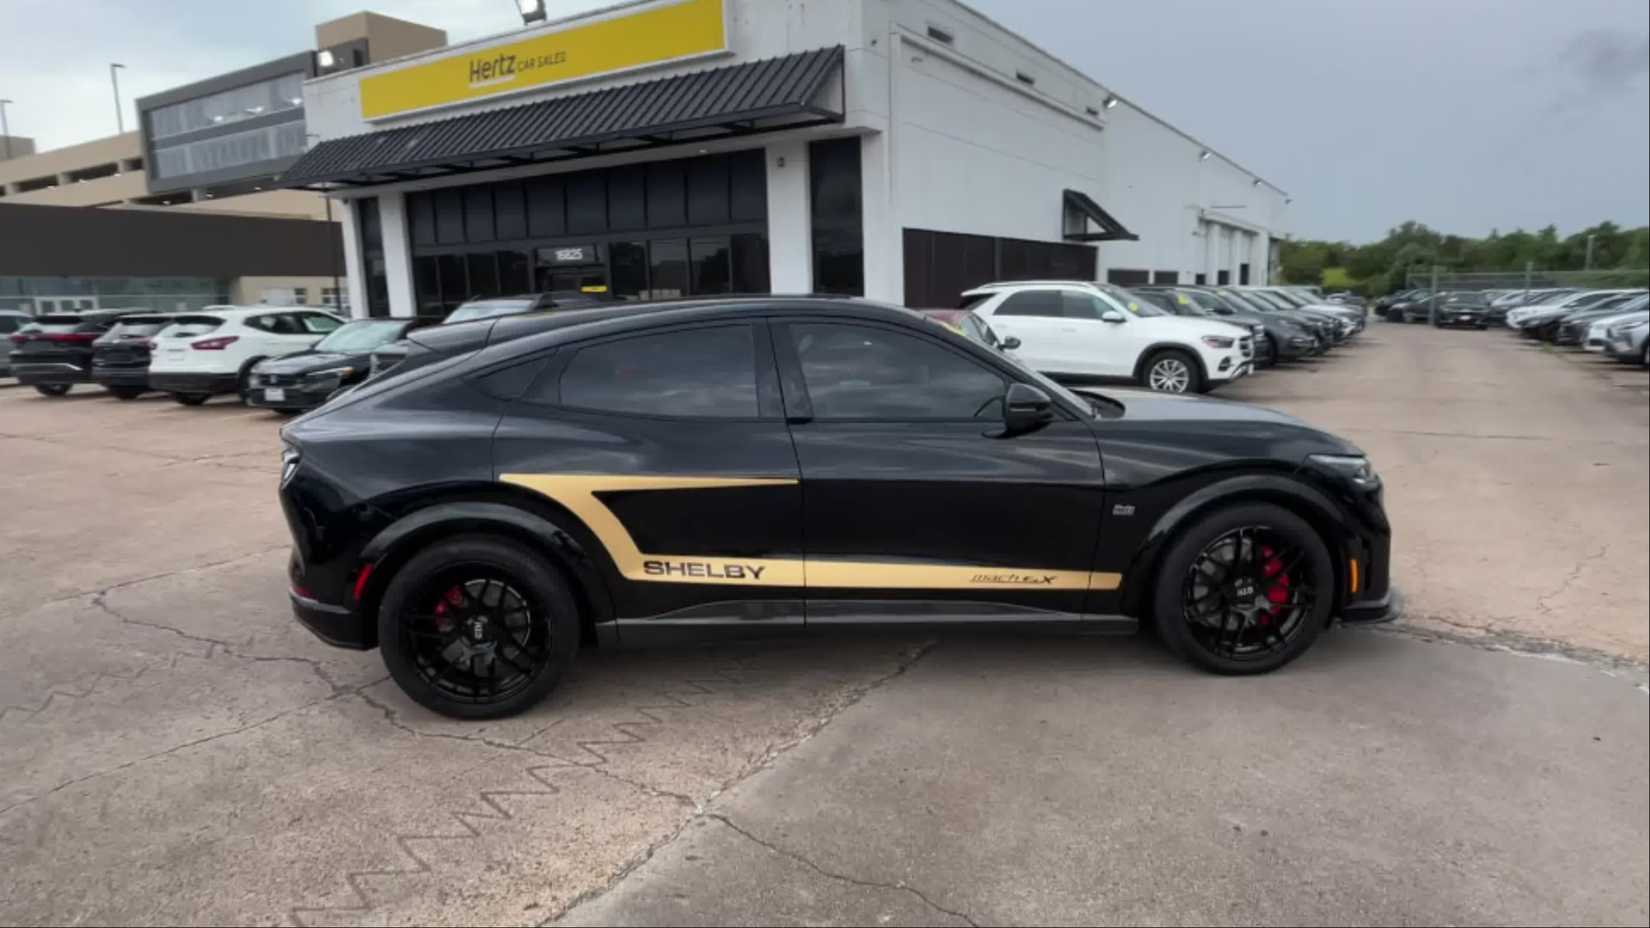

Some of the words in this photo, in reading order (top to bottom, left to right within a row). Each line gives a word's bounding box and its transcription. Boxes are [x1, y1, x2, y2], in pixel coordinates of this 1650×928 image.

[469, 52, 516, 83] Hertz
[517, 57, 537, 73] CAR
[537, 51, 567, 69] SALES
[642, 560, 765, 580] SHELBY
